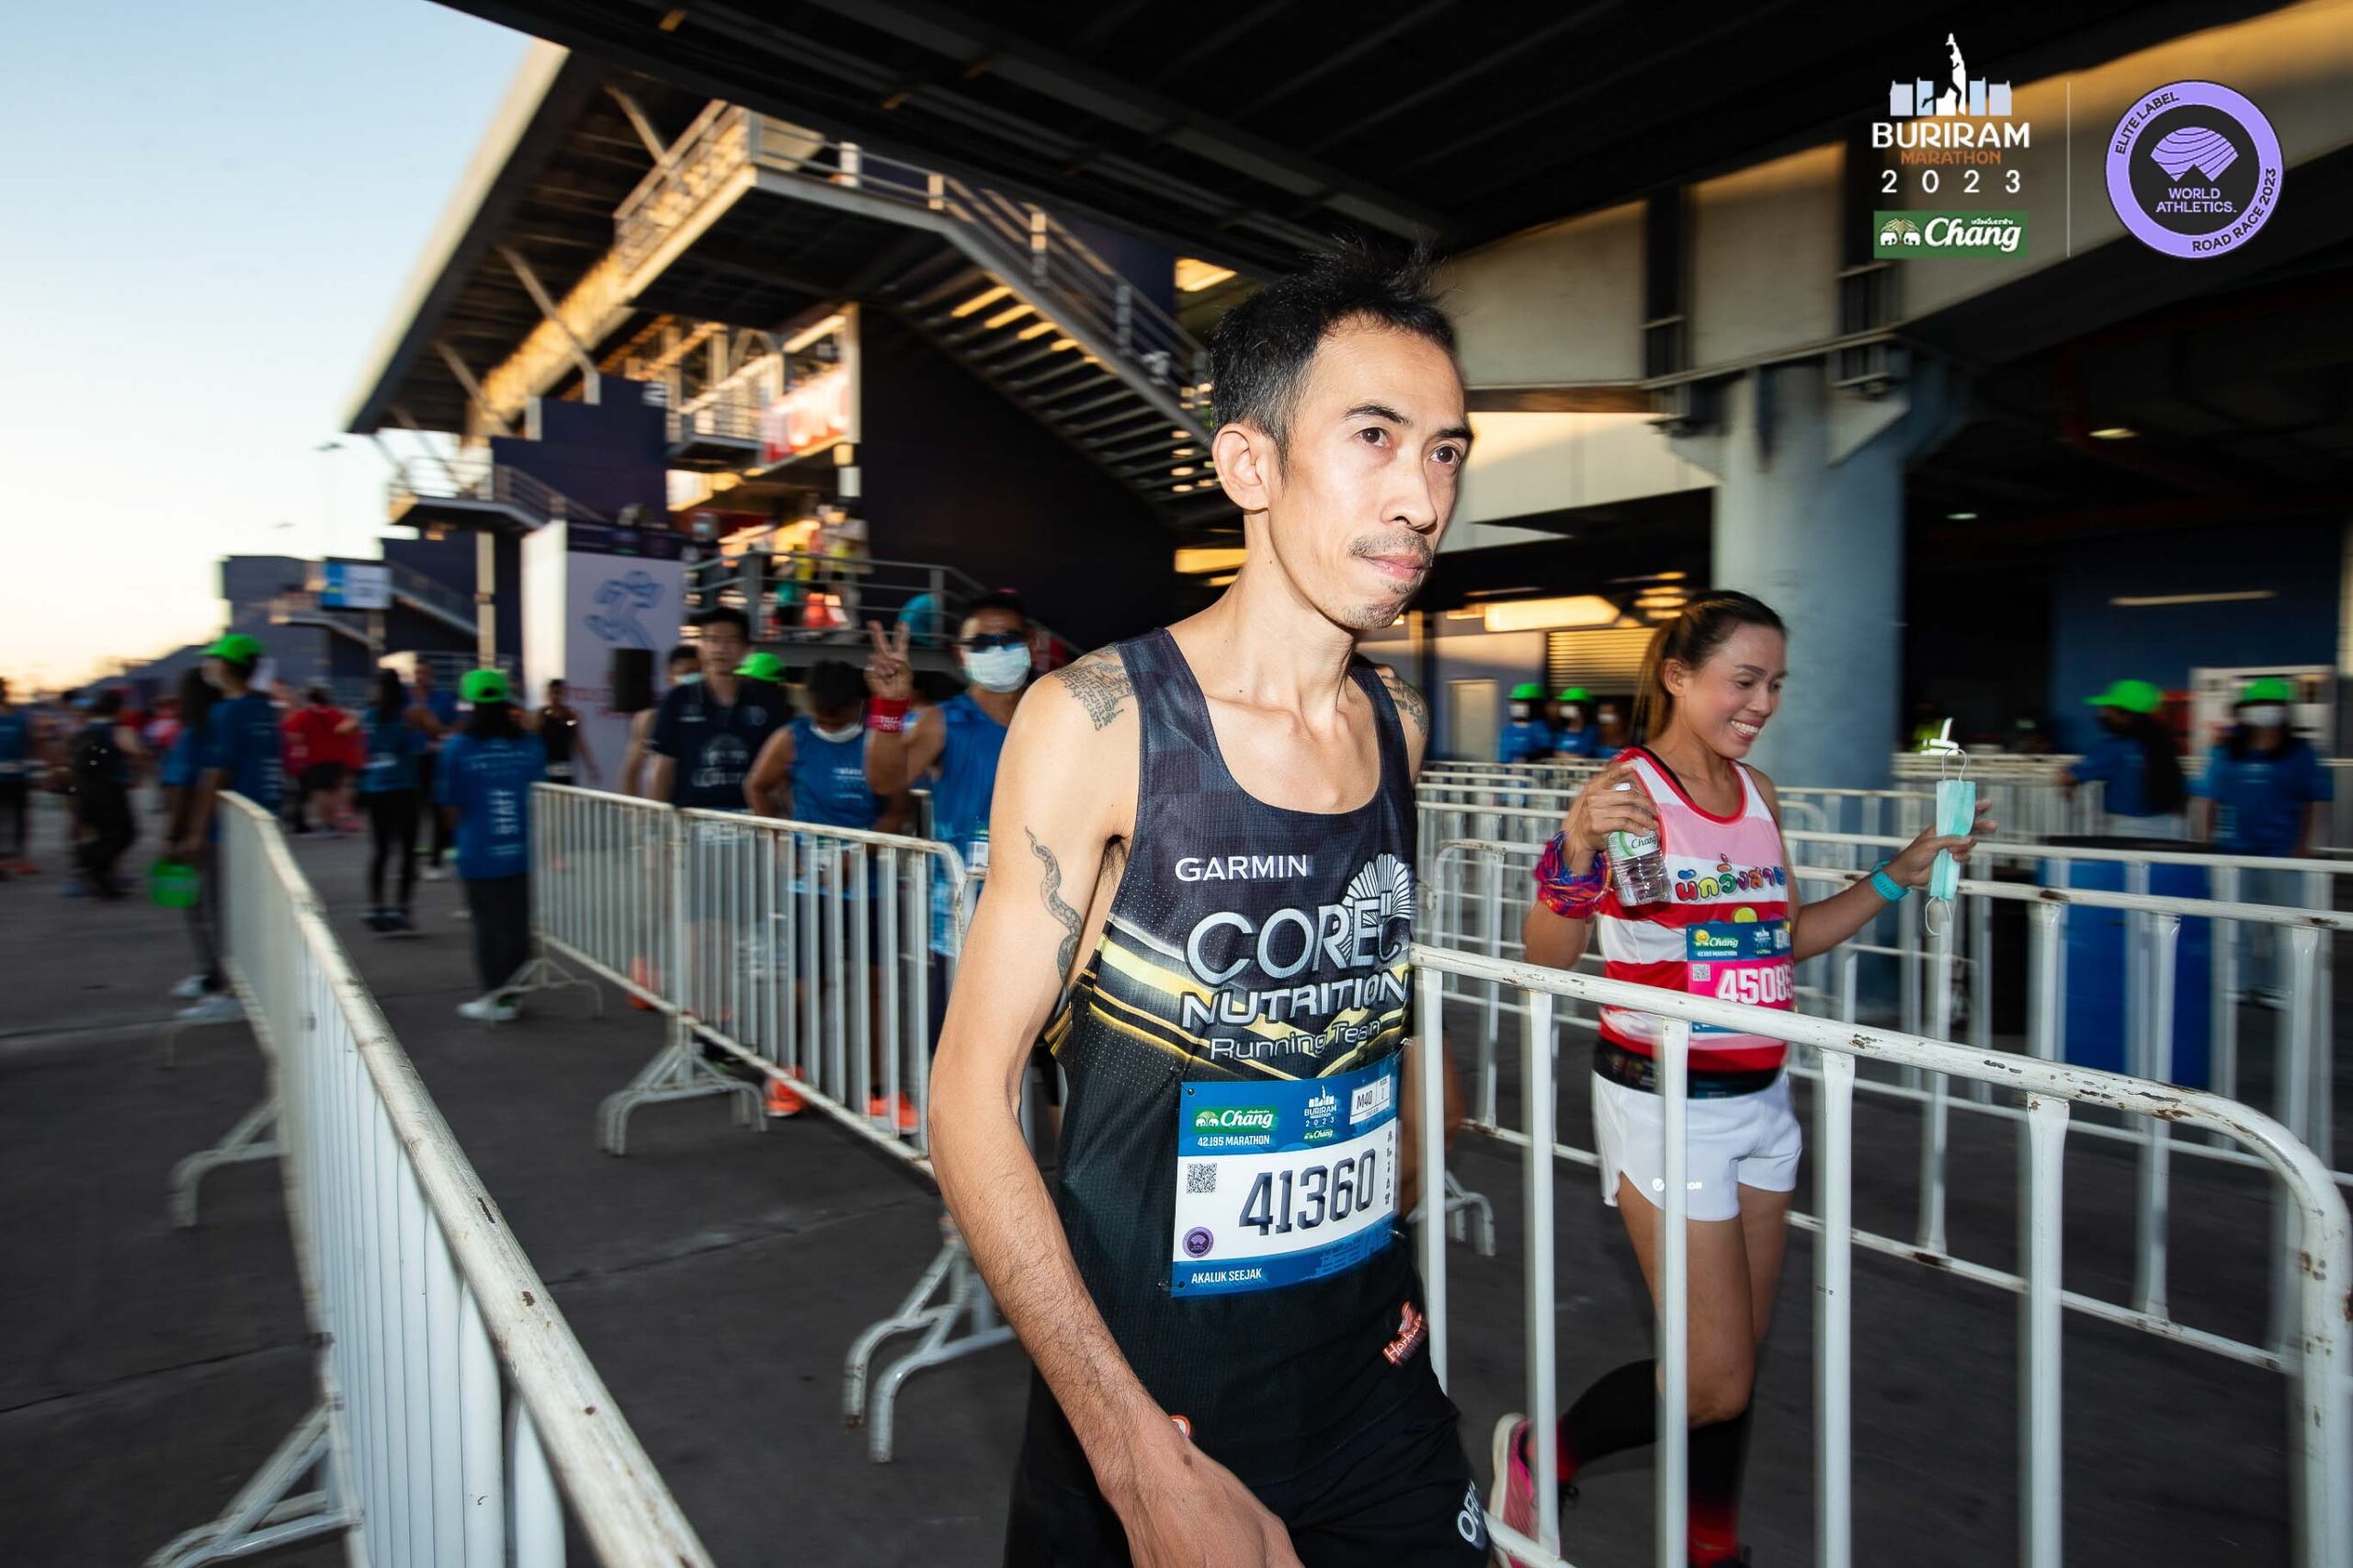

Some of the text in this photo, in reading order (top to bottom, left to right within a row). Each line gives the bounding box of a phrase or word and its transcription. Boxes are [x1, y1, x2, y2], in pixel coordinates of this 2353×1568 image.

[1175, 854, 1308, 881] GARMIN
[1710, 937, 1739, 948] Chang
[1182, 971, 1409, 1028] NUTRITION
[1211, 1032, 1327, 1060] Running
[1356, 1090, 1373, 1110] M40
[1221, 1109, 1274, 1129] Chang
[1304, 1105, 1337, 1117] BURIRAM
[1198, 1135, 1270, 1147] 42.195 MARATHON
[1313, 1130, 1334, 1139] Chang
[1239, 1148, 1376, 1236] 41360
[1191, 1267, 1263, 1284] AKALUK SEEJAK
